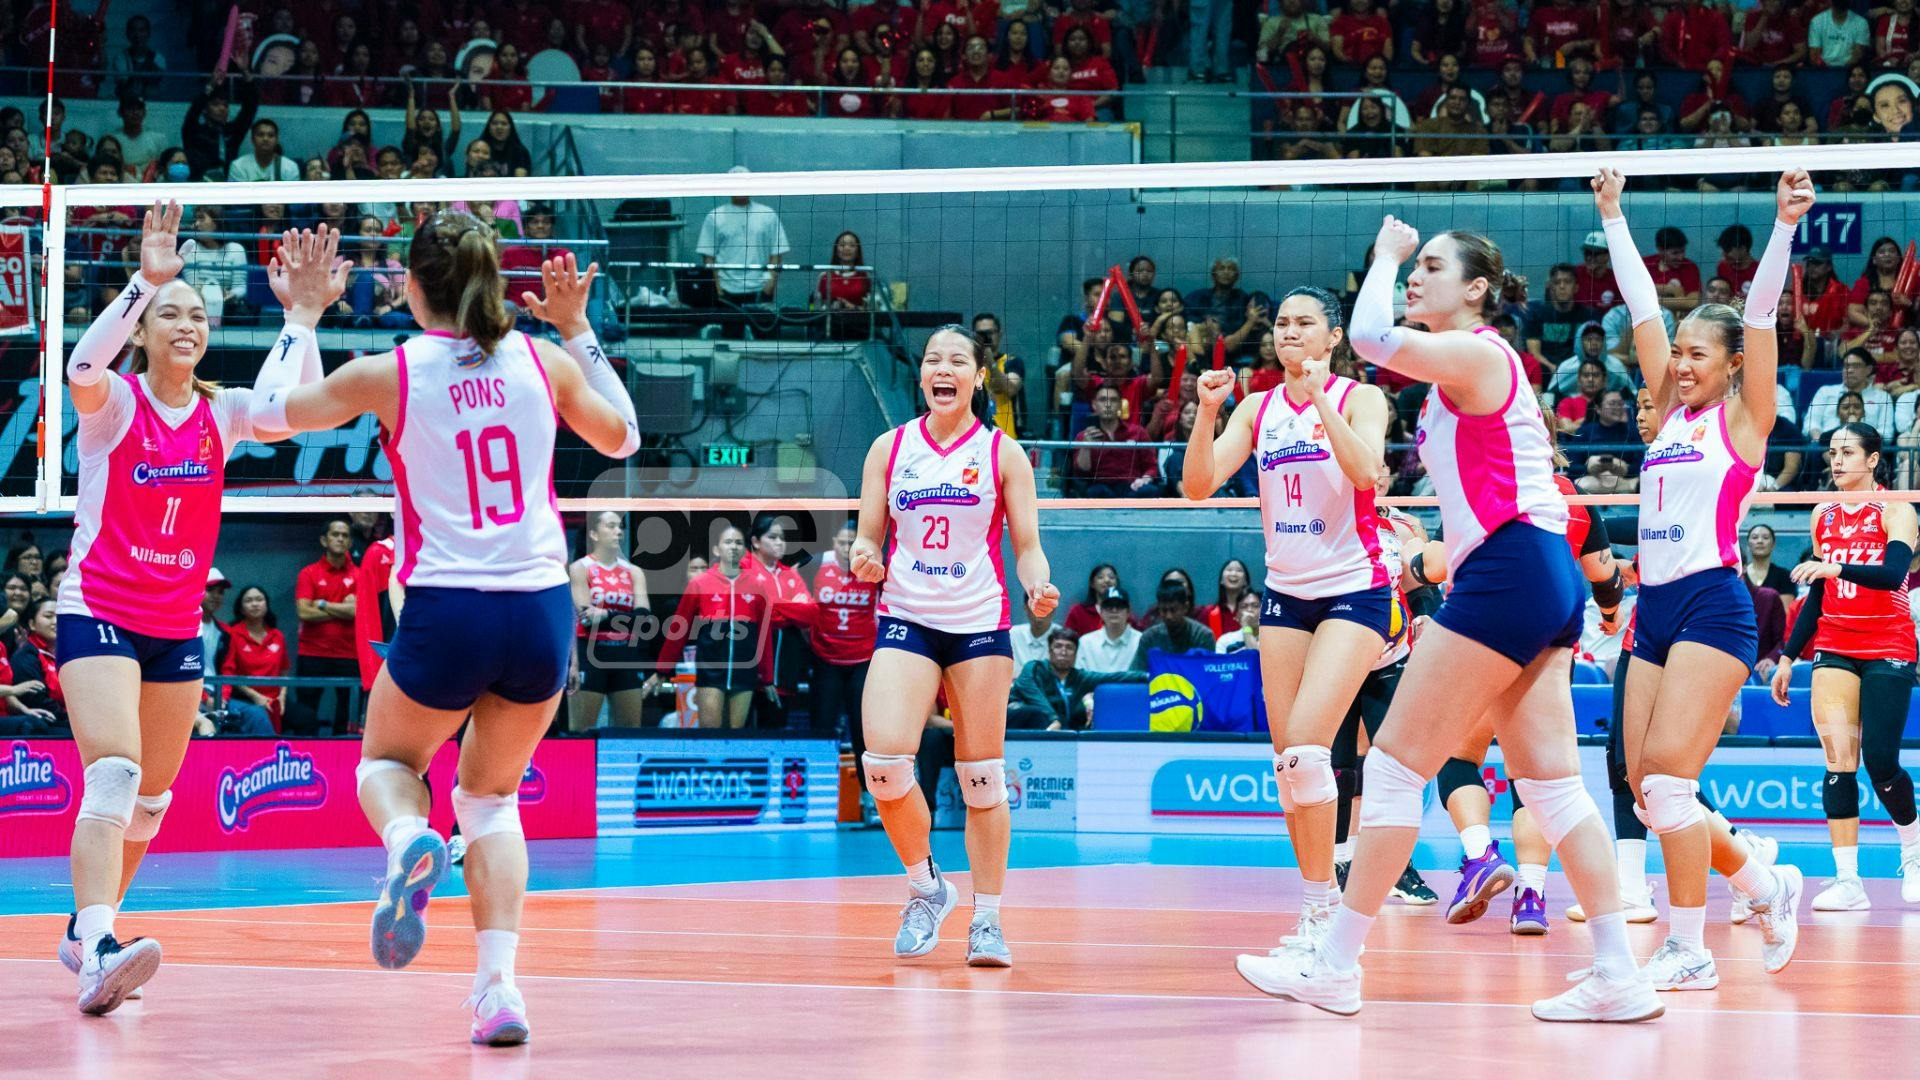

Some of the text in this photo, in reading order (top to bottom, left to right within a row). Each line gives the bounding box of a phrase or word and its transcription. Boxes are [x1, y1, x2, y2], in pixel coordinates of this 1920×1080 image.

[1798, 213, 1856, 244] 117
[449, 377, 506, 415] PONS
[708, 446, 749, 465] EXIT
[1260, 440, 1320, 471] Creamline
[133, 460, 209, 485] Creamline
[455, 425, 526, 530] 19
[896, 484, 970, 511] Creamline
[1283, 473, 1303, 507] 14
[1657, 475, 1664, 512] 1
[161, 496, 181, 535] 11
[1275, 522, 1307, 534] Allianz
[922, 515, 950, 550] 23
[130, 545, 176, 566] Allianz
[911, 560, 949, 576] Allianz
[820, 586, 871, 606] Gazz
[837, 608, 850, 631] 9
[885, 623, 909, 641] 23
[97, 623, 119, 645] 11
[1203, 661, 1250, 672] VOLLEYBALL
[0, 750, 52, 789] mline
[219, 749, 312, 826] Creamline
[652, 766, 752, 801] watsons
[1026, 777, 1074, 791] PREMIER
